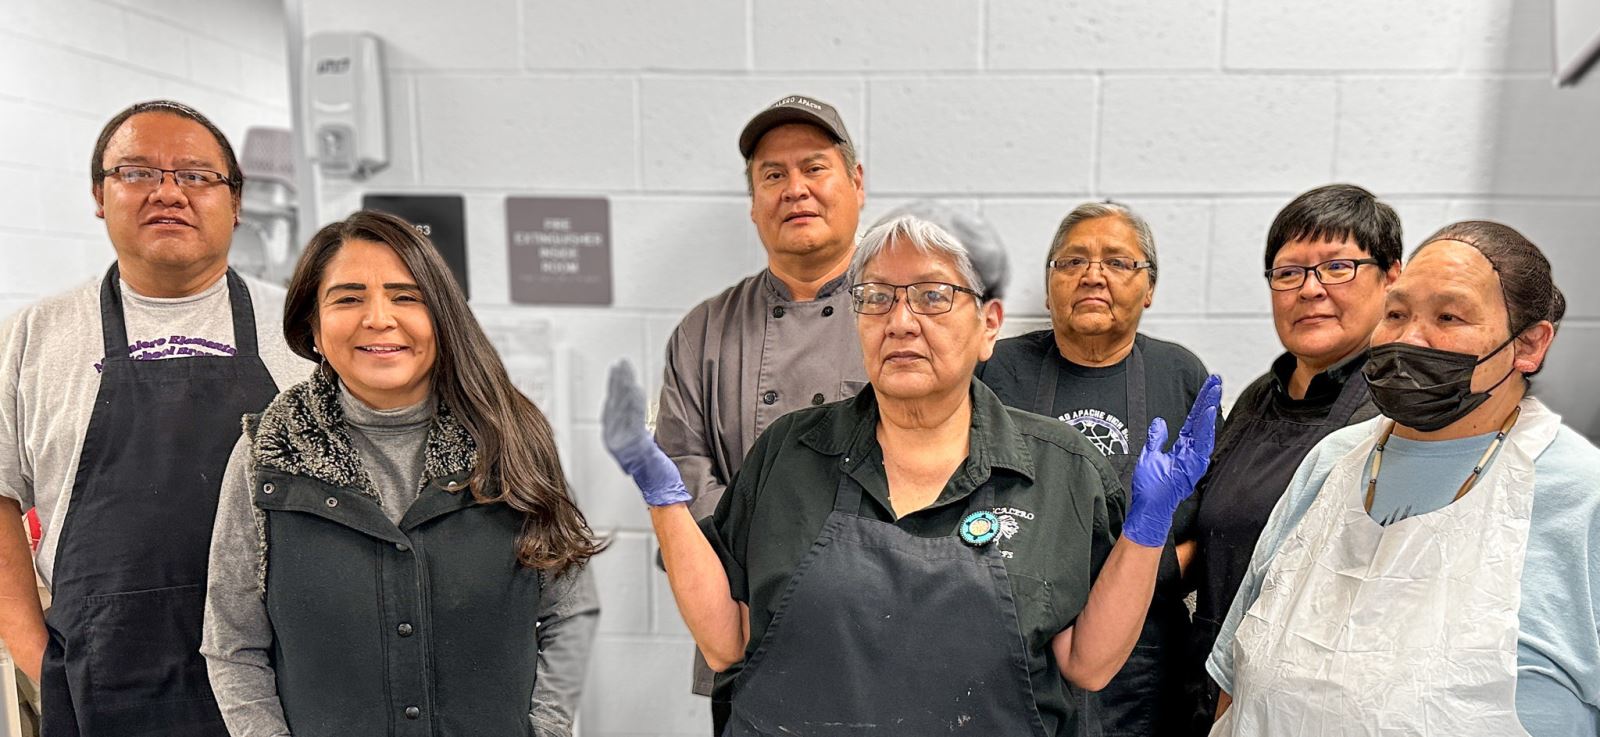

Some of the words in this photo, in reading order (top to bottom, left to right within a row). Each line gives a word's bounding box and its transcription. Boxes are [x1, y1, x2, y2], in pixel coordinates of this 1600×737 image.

[774, 97, 795, 108] ALERO
[411, 225, 431, 236] 63
[168, 335, 237, 357] Elementa
[129, 346, 176, 361] chool
[1072, 409, 1106, 420] APACHE
[1105, 414, 1124, 430] HIGH
[992, 507, 1035, 520] CALERO
